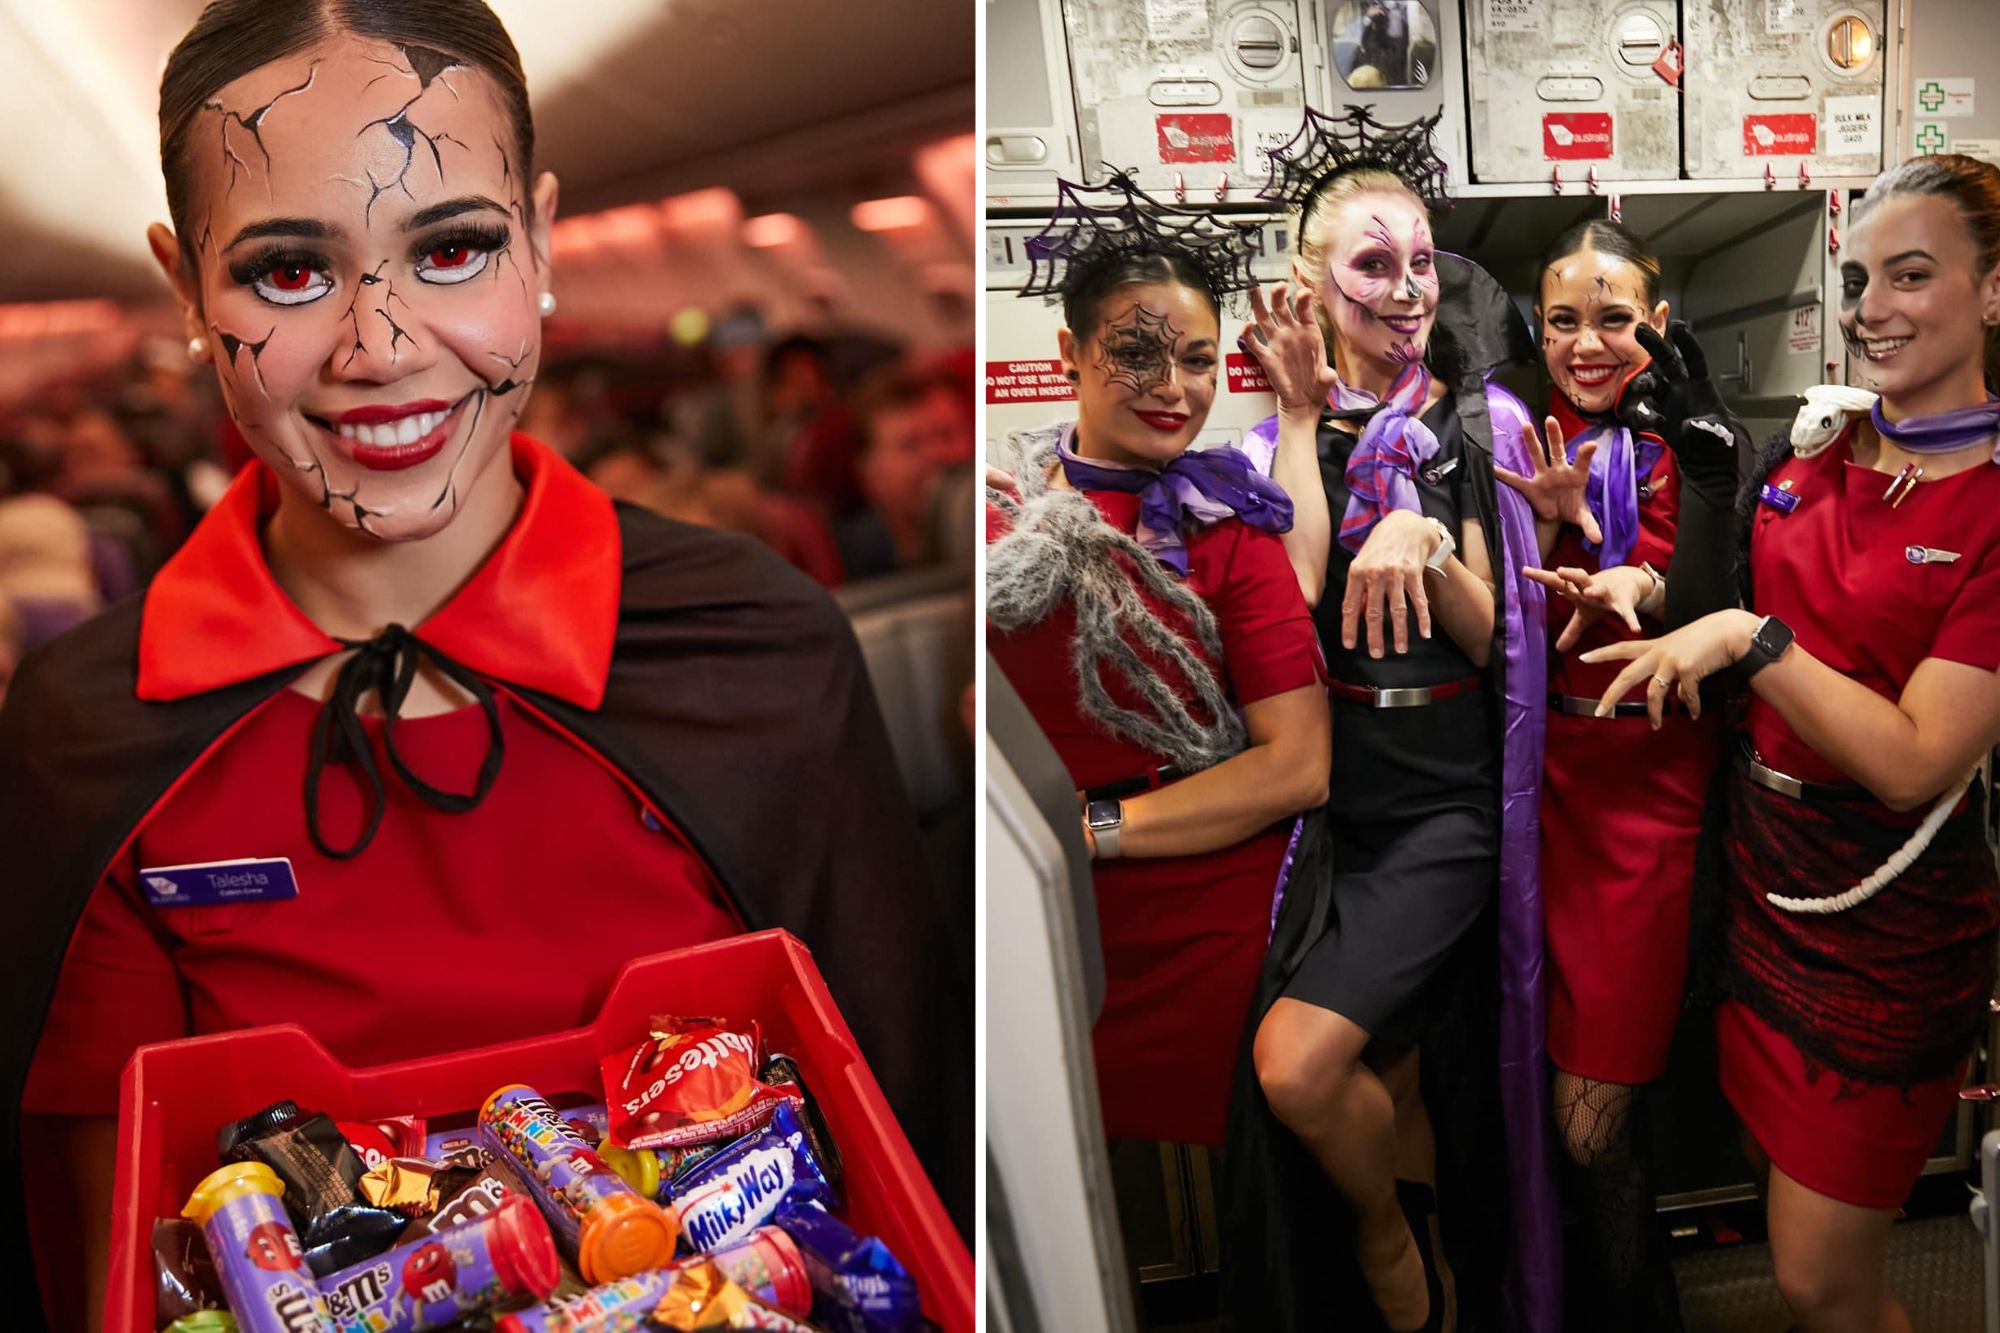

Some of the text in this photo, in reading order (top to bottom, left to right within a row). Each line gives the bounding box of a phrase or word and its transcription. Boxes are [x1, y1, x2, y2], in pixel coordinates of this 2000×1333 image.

[1008, 362, 1053, 373] CAUTION
[1228, 366, 1243, 377] DO
[995, 375, 1016, 386] NOT
[1018, 374, 1039, 385] USE
[994, 385, 1073, 398] AN OVEN INSERT
[206, 872, 269, 889] Talesha
